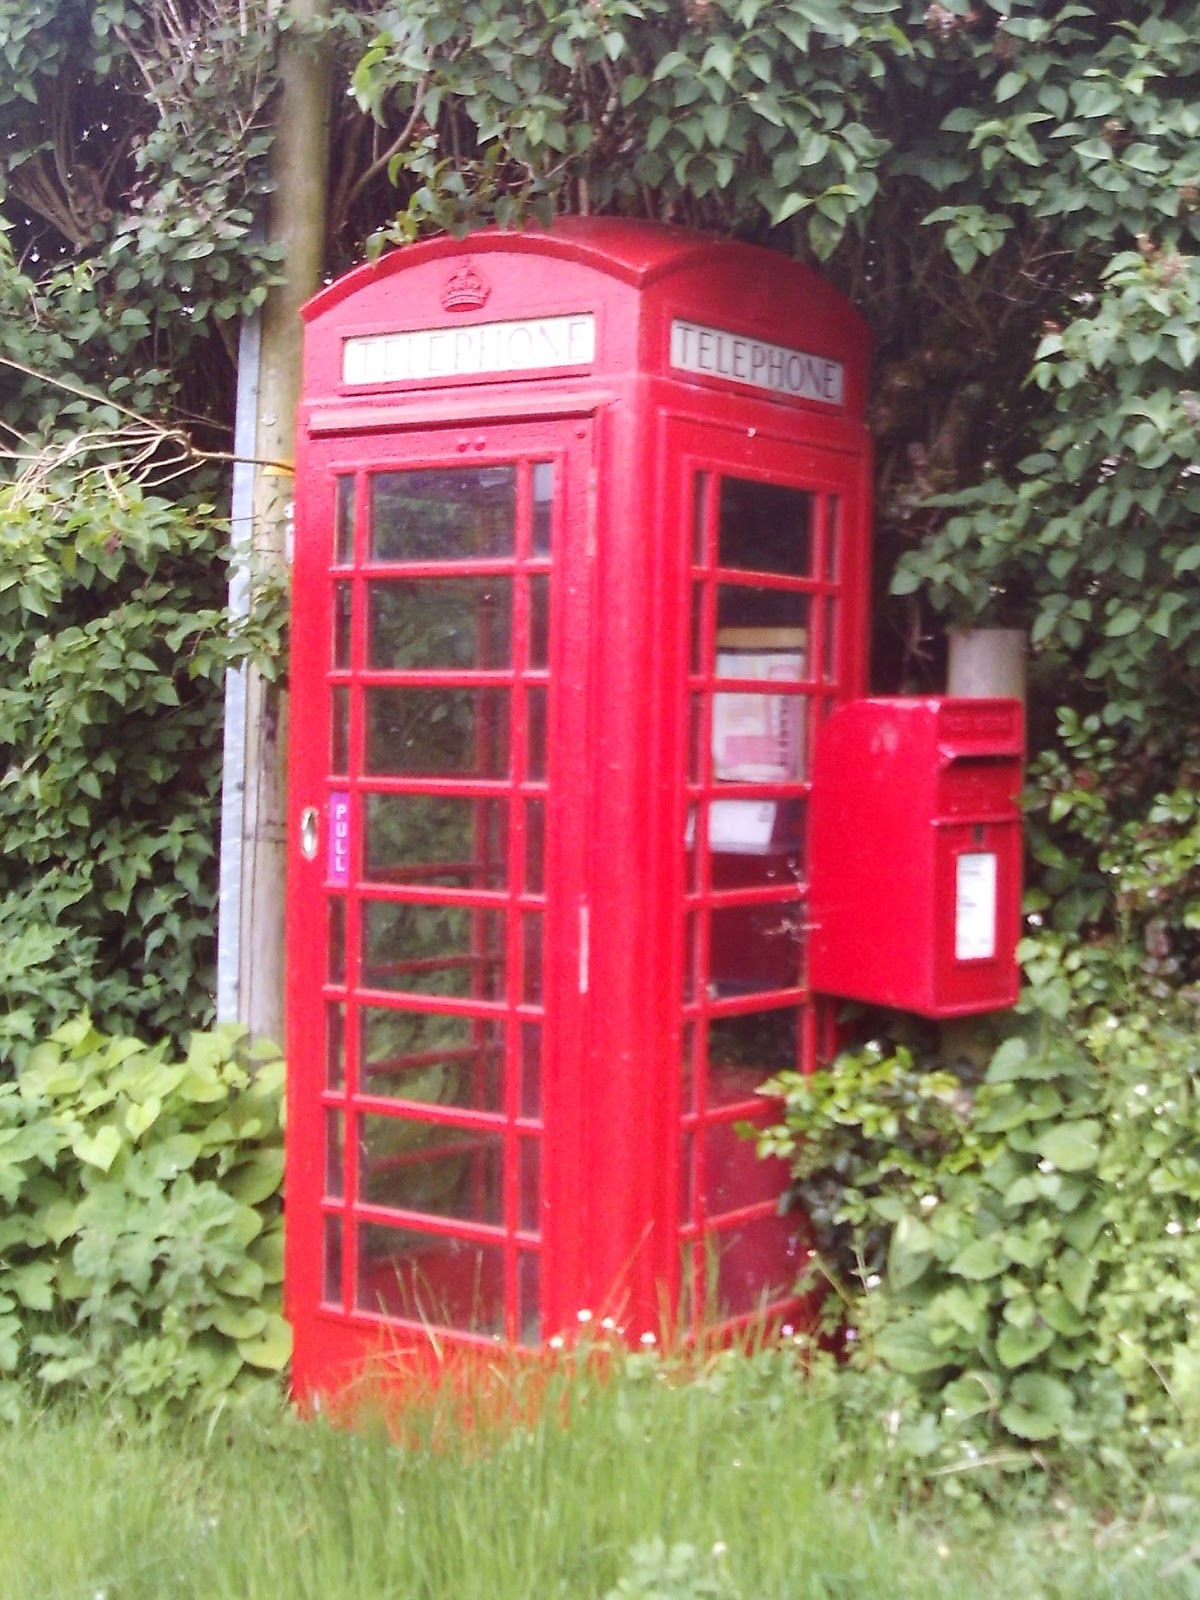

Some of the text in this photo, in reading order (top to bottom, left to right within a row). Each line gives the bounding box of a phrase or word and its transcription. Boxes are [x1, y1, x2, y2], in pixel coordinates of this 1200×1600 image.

[357, 321, 587, 377] TELEPHONE
[676, 325, 837, 399] TELEPHONE
[335, 803, 347, 872] PULL
